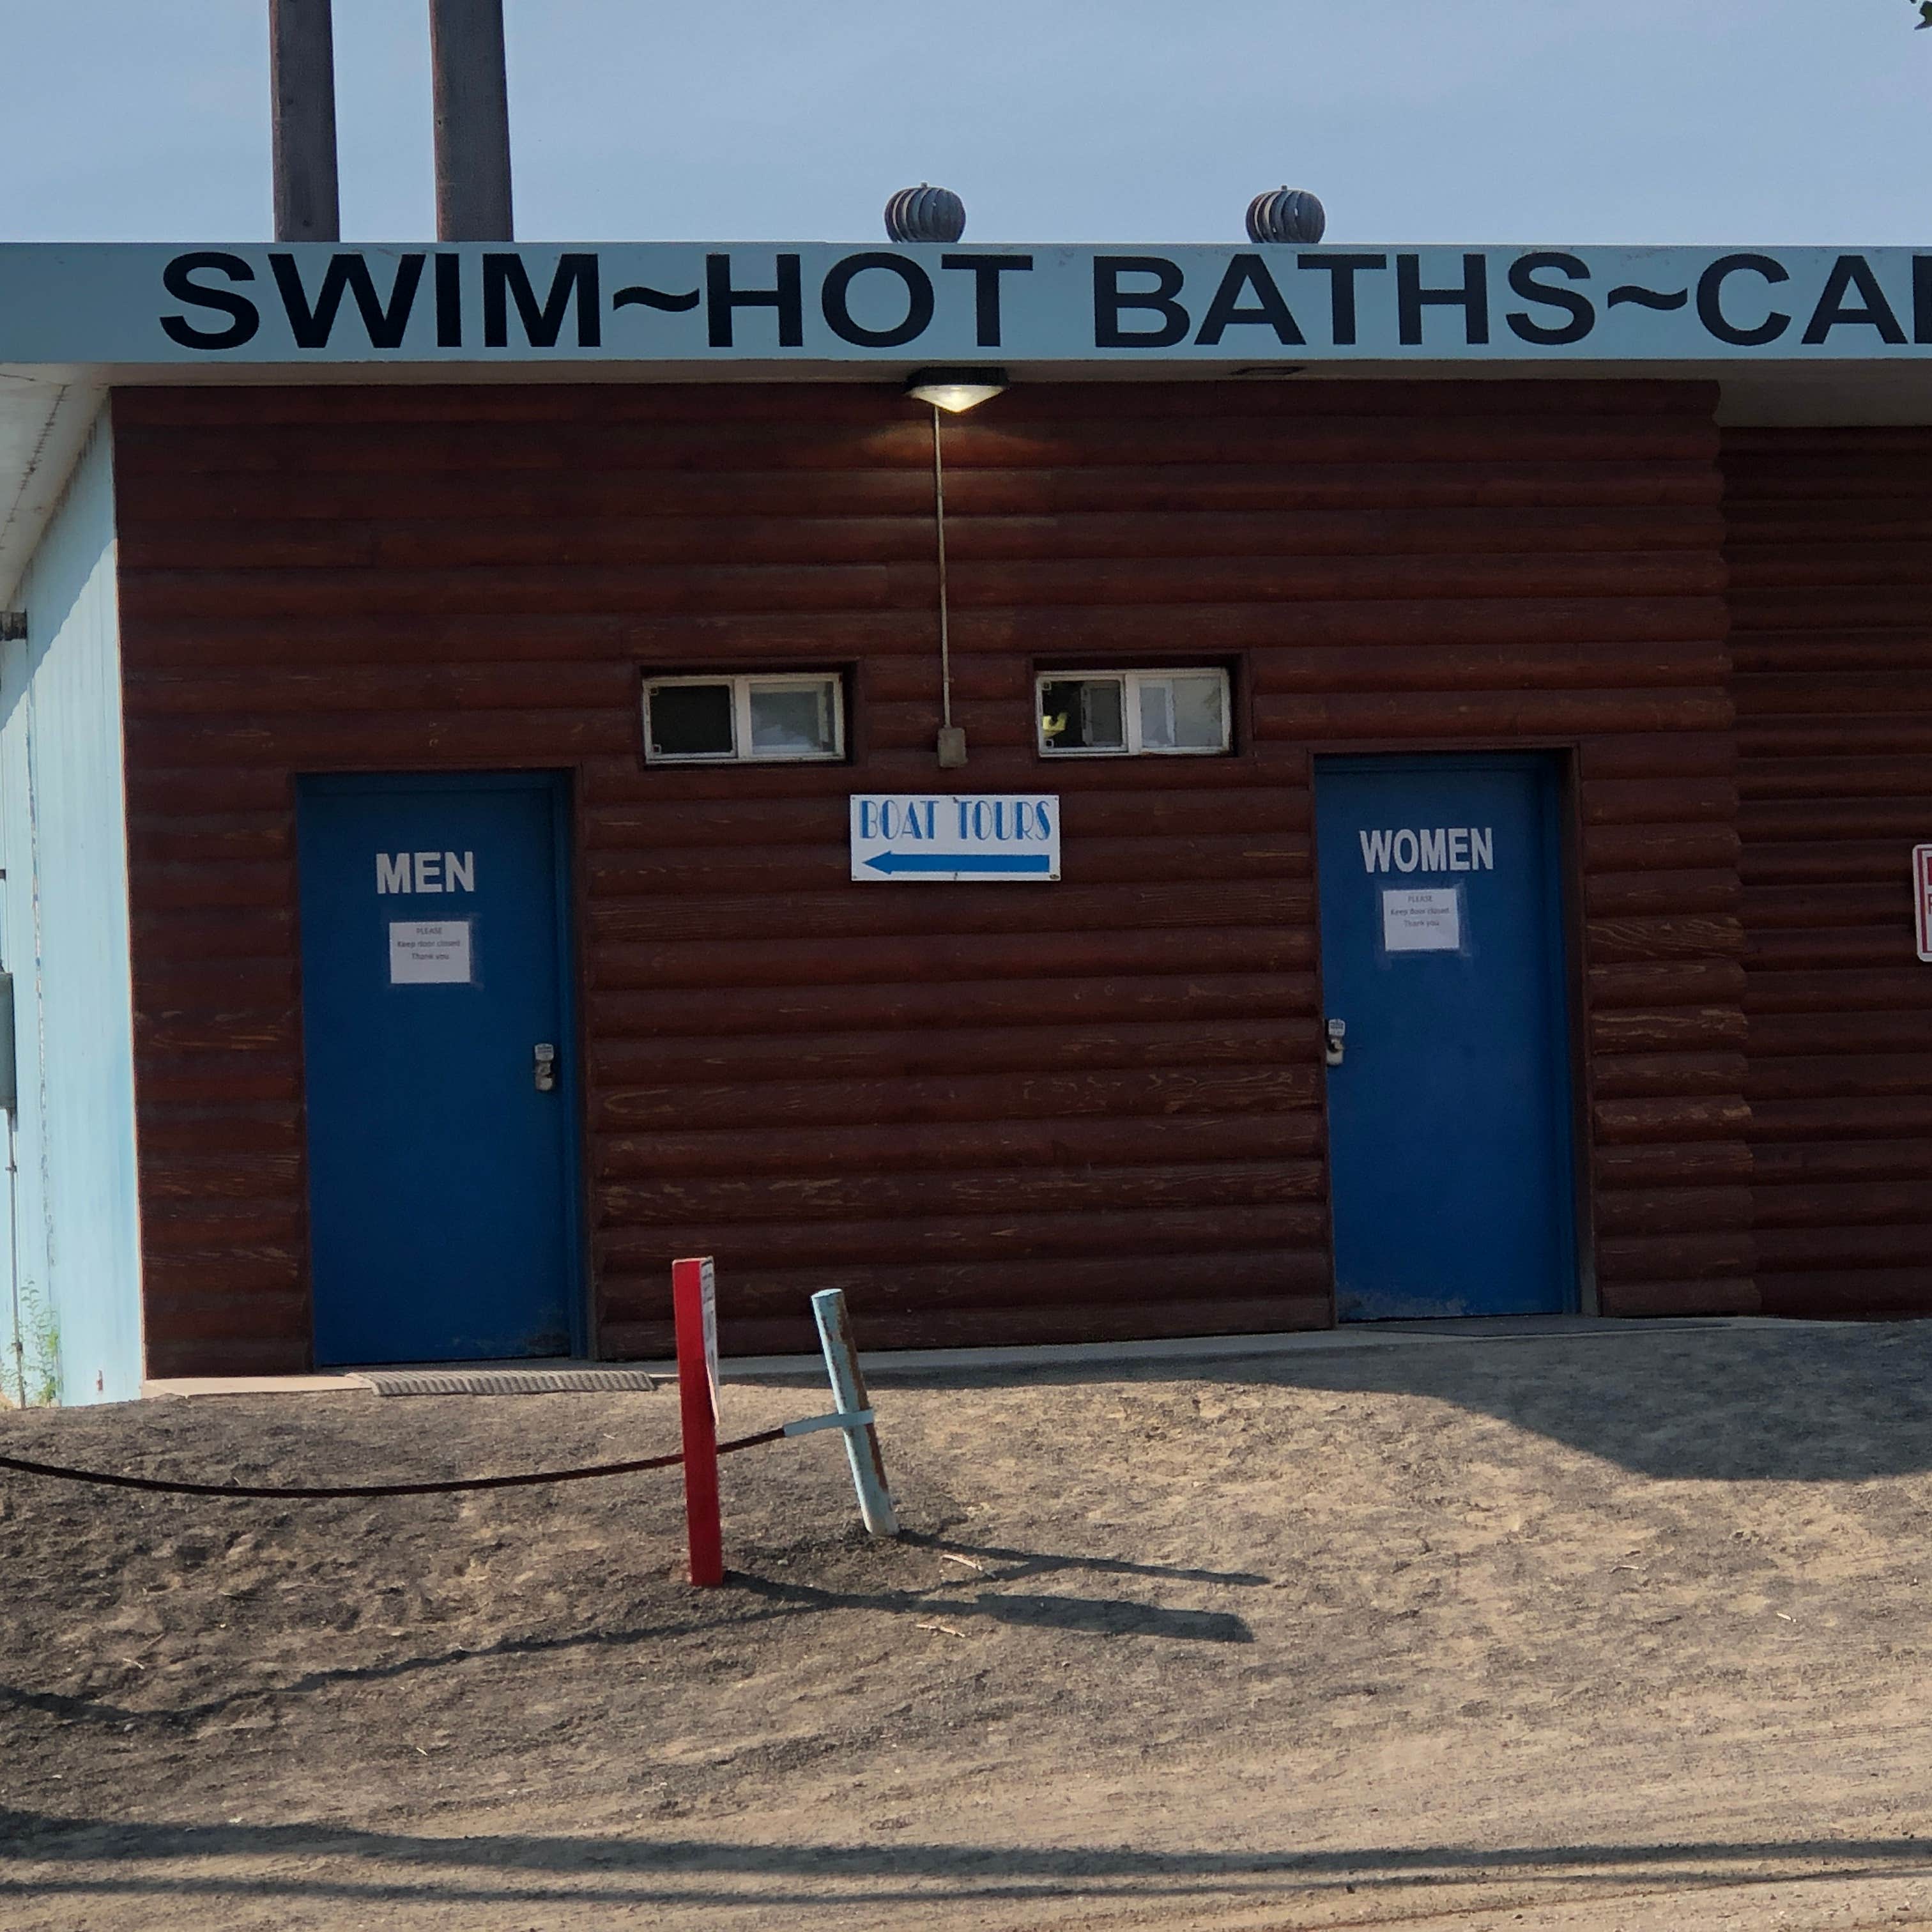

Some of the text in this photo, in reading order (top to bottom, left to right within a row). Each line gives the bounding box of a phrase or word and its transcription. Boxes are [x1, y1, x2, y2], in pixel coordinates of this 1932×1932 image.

[859, 800, 1051, 841] BOAT TOURS
[1359, 828, 1494, 873] WOMEN
[376, 851, 475, 894] MEN
